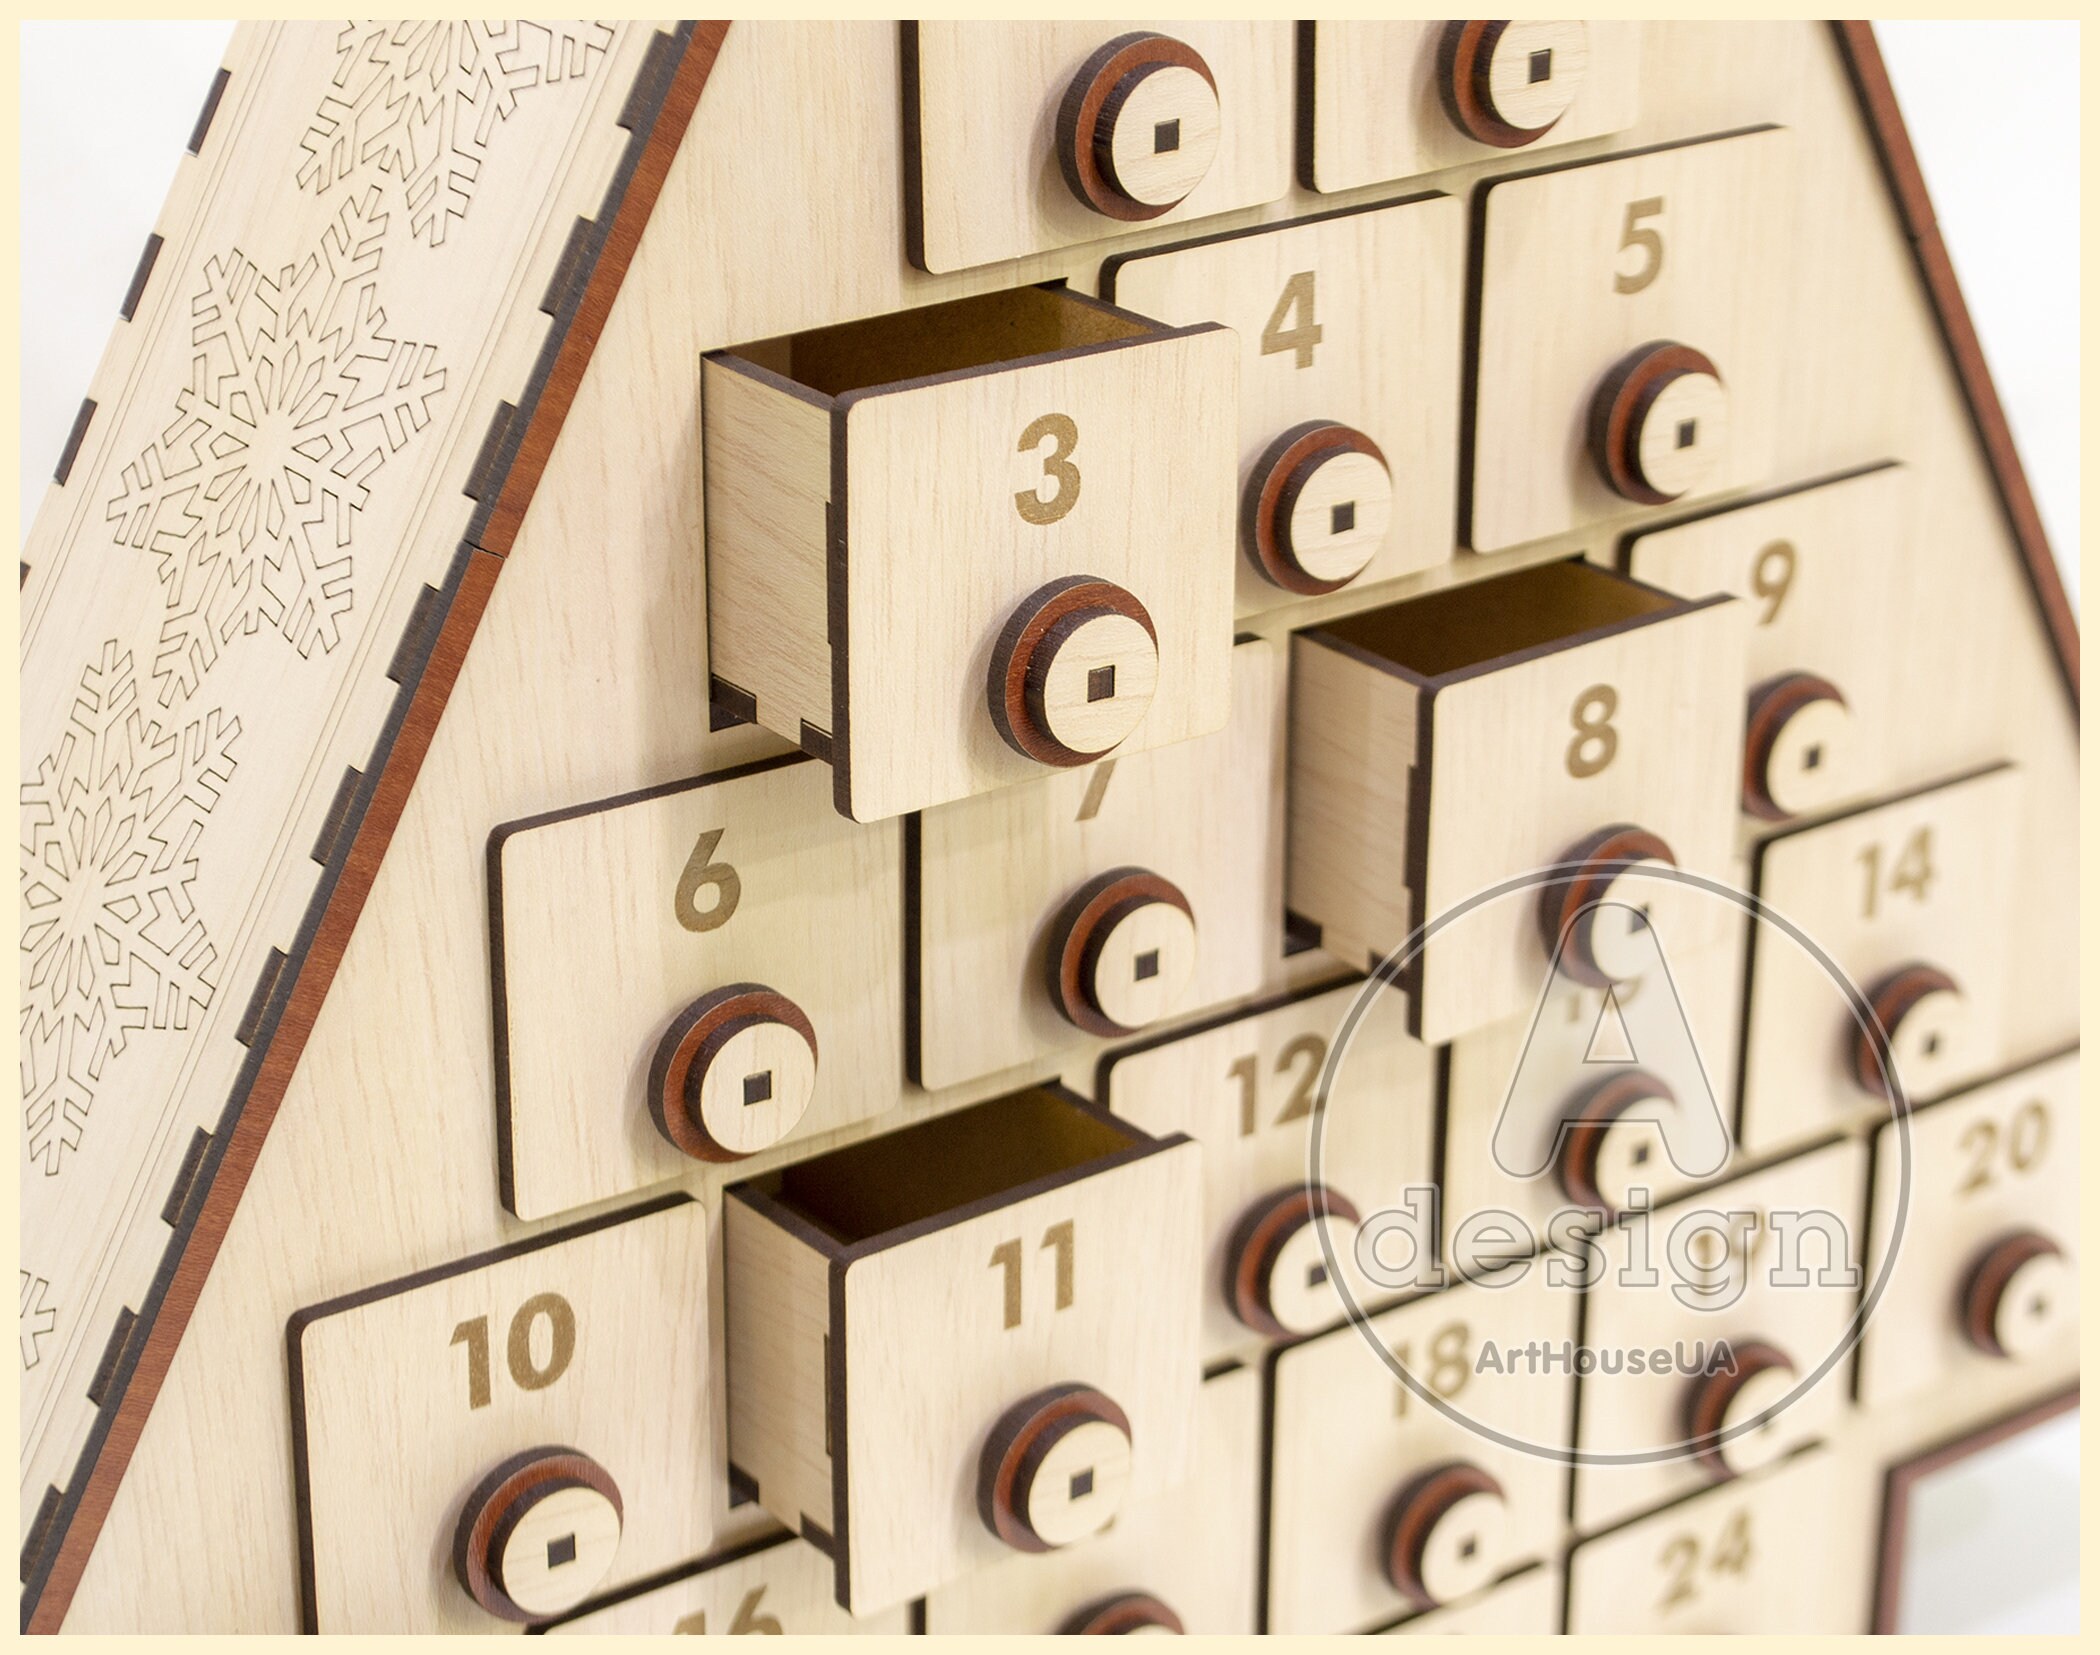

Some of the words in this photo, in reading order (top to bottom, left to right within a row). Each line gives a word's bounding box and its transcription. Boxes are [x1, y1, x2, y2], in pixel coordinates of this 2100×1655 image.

[1613, 197, 1664, 295] 5
[1260, 271, 1323, 369] 4
[1014, 413, 1081, 525] 3
[1751, 539, 1796, 626] 9
[1564, 685, 1618, 779] 8
[674, 828, 741, 933] 6
[1855, 826, 1937, 919] 14
[1227, 1033, 1328, 1136] 12
[1956, 1101, 2049, 1196] 20
[988, 1219, 1074, 1330] 11
[449, 1292, 576, 1409] 10
[1392, 1321, 1470, 1418] 18
[1655, 1510, 1751, 1612] 24
